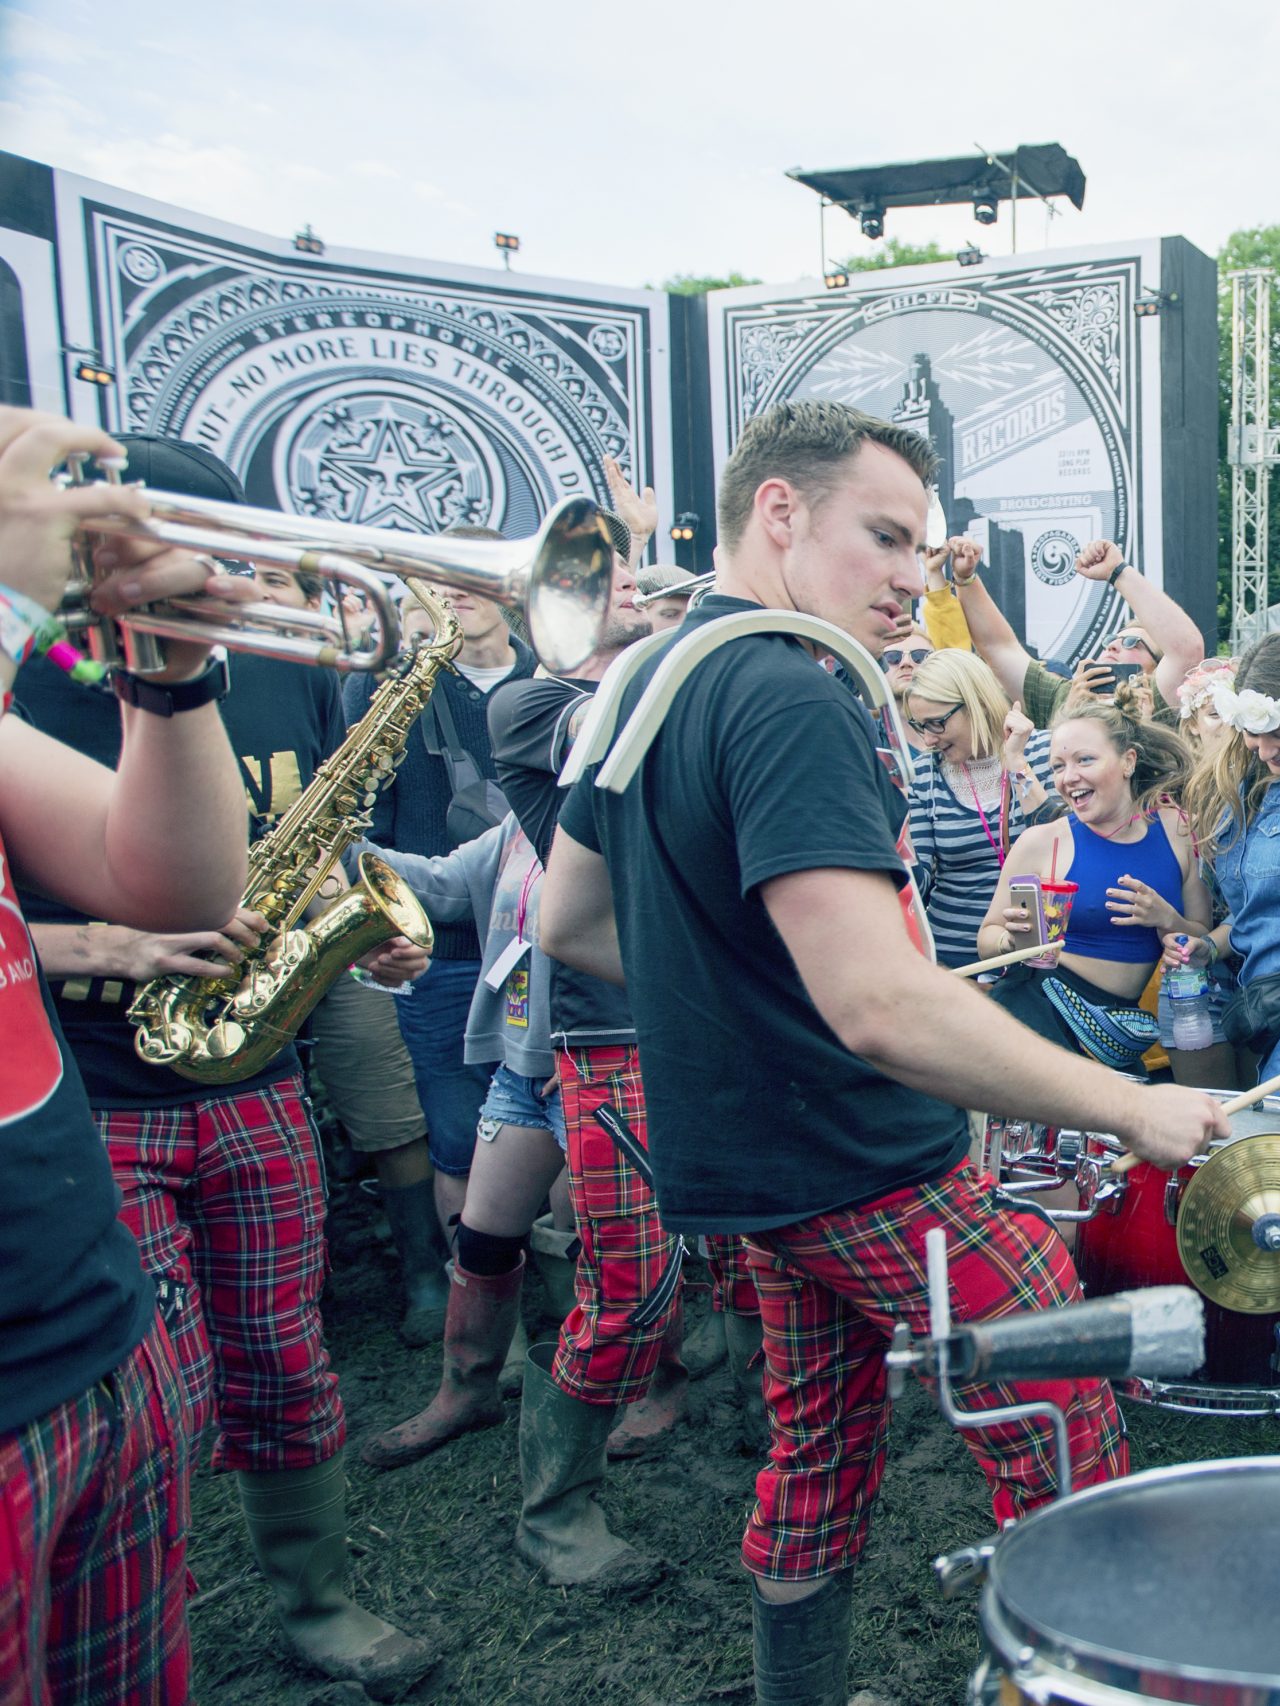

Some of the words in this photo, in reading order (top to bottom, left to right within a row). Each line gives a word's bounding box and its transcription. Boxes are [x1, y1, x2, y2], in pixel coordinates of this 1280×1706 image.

[252, 312, 514, 373] STEREOPHONIC
[269, 336, 358, 374] MORE
[370, 336, 438, 369] LIES
[452, 358, 568, 462] THROUGH
[962, 388, 1066, 468] RECORDS
